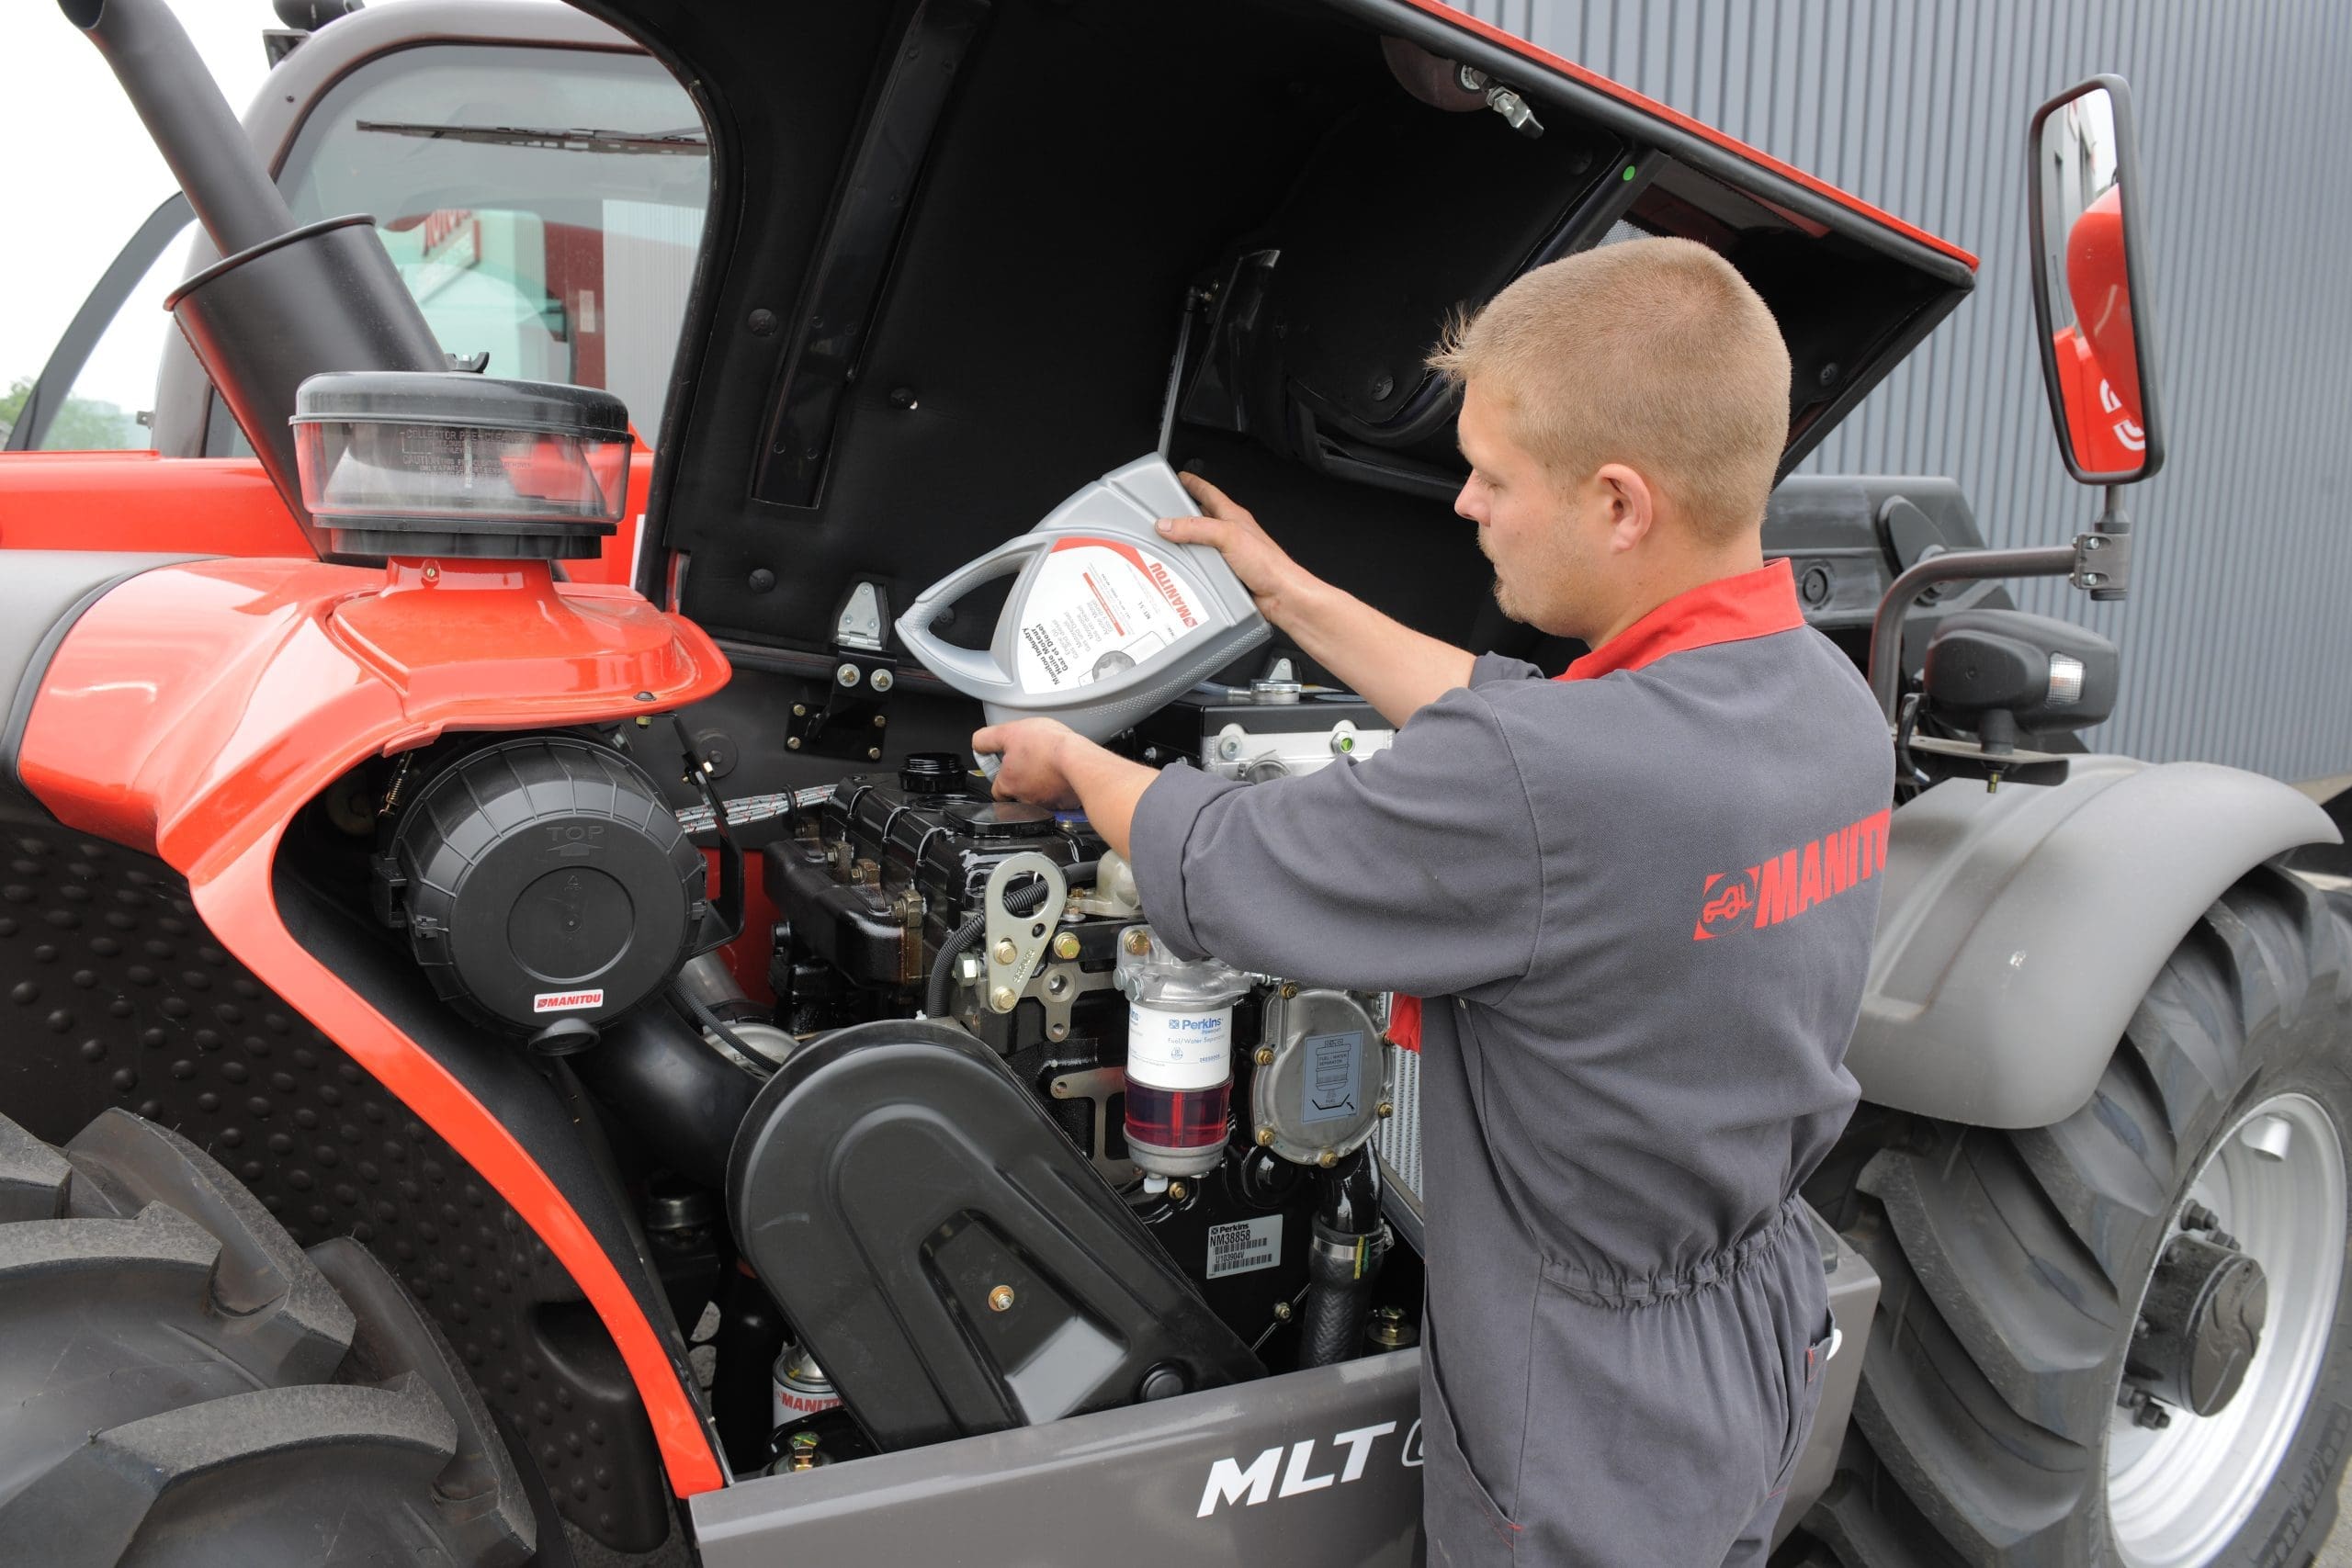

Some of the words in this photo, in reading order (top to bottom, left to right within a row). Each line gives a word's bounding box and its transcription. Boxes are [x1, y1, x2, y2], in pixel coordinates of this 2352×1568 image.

[1149, 562, 1193, 619] MANITOU
[1021, 626, 1042, 657] Industry
[1030, 626, 1050, 655] Moteur
[1035, 622, 1053, 647] Diesel
[1050, 647, 1059, 657] et
[1039, 655, 1060, 685] Manitou
[1046, 654, 1062, 674] Huile
[1056, 656, 1069, 671] Gaz
[546, 826, 605, 840] TOP
[548, 994, 601, 1007] MANITOU
[1182, 1018, 1222, 1030] Perkins
[1210, 1229, 1250, 1247] NM38858
[1219, 1224, 1250, 1234] Perkins
[1196, 1420, 1396, 1518] MLT
